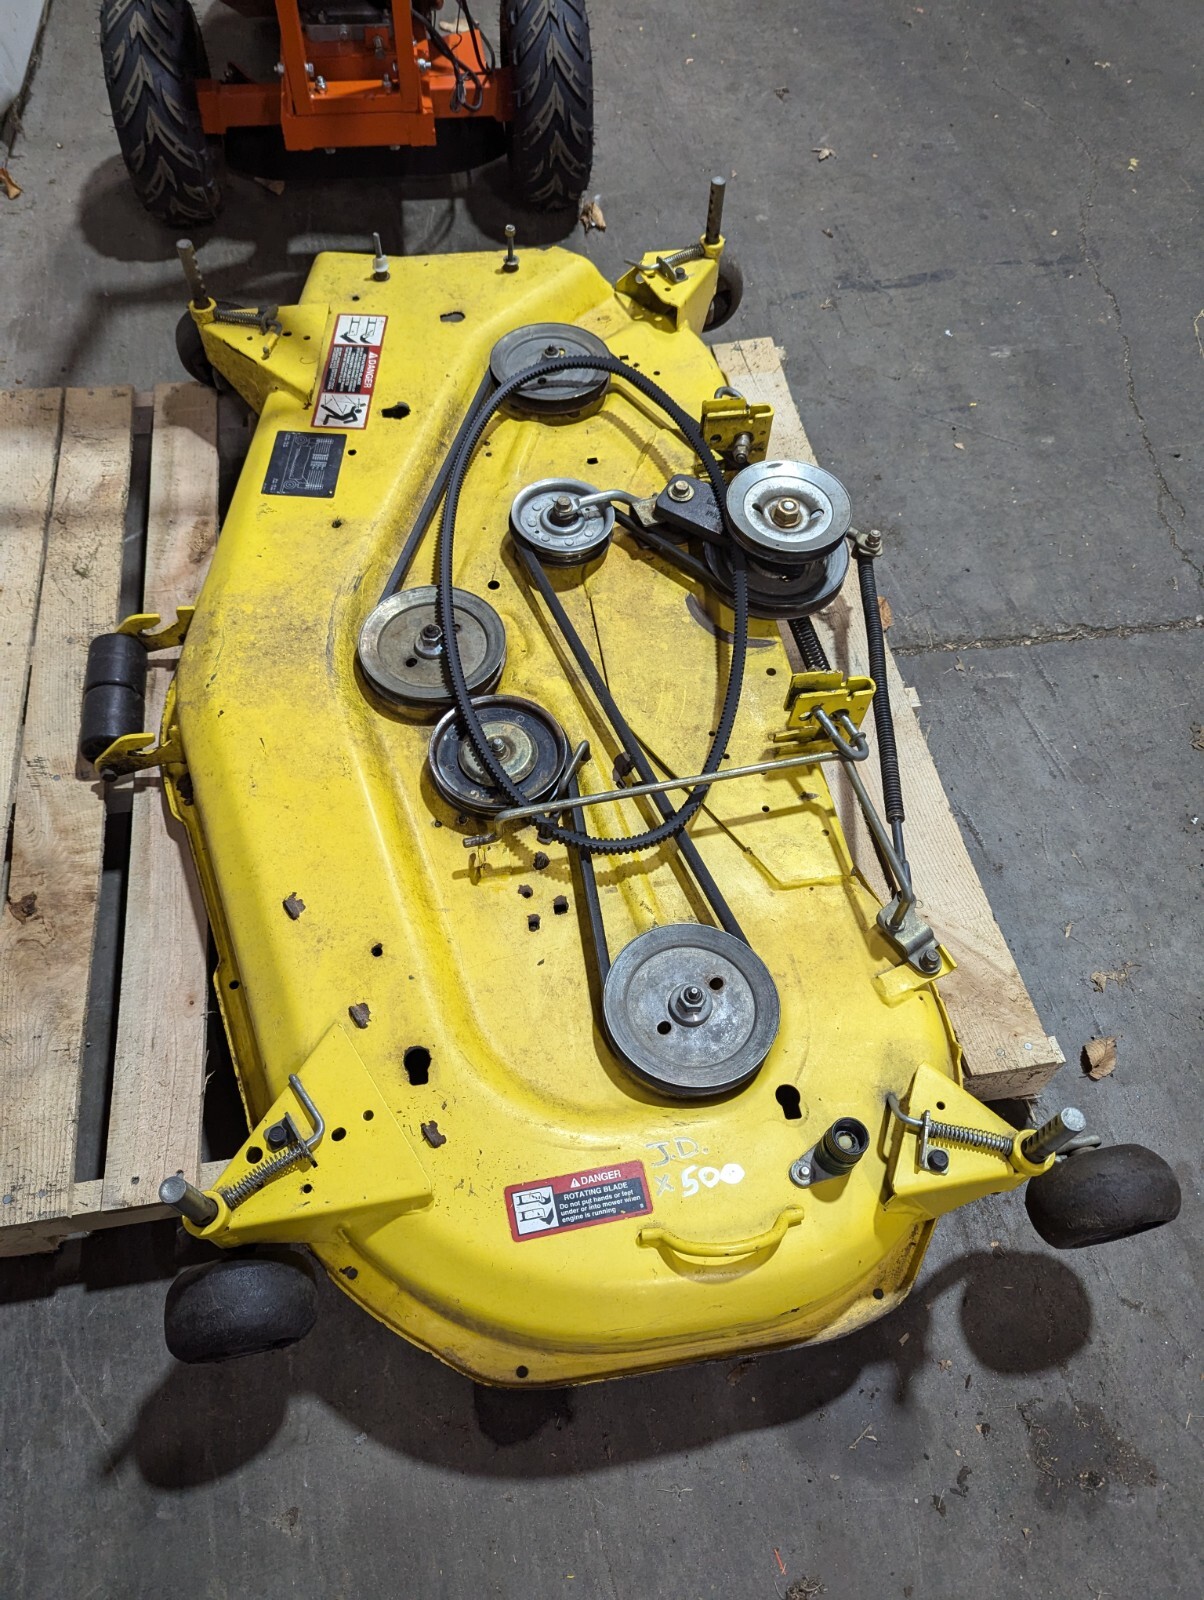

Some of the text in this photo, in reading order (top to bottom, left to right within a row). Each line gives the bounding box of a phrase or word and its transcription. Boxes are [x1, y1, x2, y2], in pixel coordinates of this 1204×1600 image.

[364, 360, 378, 388] DANGER
[645, 1136, 709, 1168] J.D.
[580, 1169, 621, 1185] DANGER
[563, 1181, 629, 1201] ROTATING BLADE
[569, 1200, 581, 1208] not
[581, 1198, 592, 1207] put
[593, 1195, 613, 1203] hands
[621, 1189, 634, 1197] feet
[560, 1207, 580, 1217] under
[588, 1202, 601, 1210] into
[602, 1199, 623, 1208] mower
[623, 1195, 641, 1203] when
[561, 1214, 583, 1223] engine
[592, 1207, 617, 1216] running
